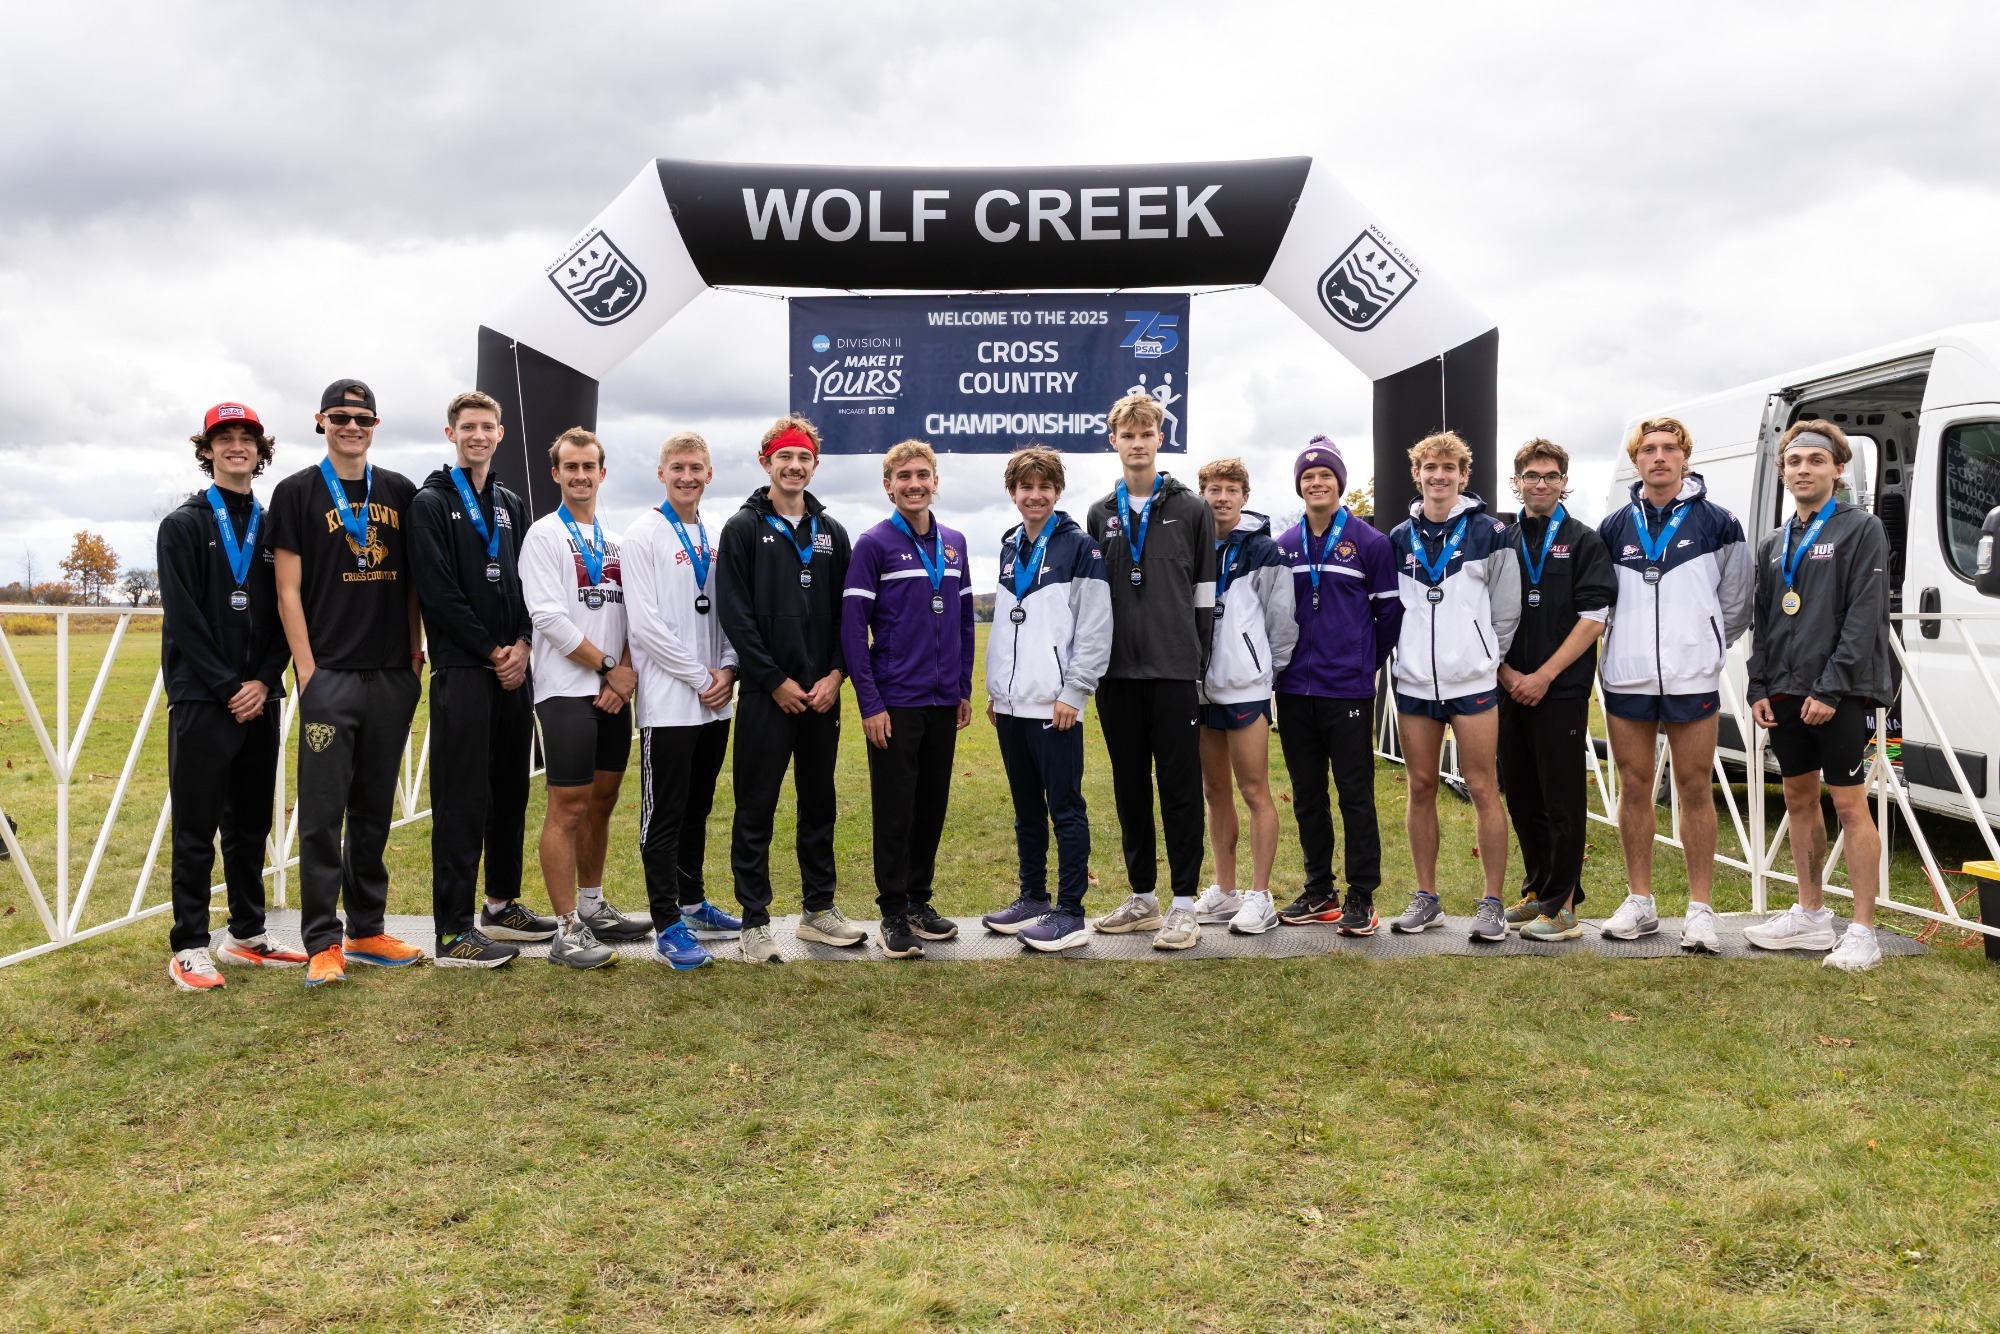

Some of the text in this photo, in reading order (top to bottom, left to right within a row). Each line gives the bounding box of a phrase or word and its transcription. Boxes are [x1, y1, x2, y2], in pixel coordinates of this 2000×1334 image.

[742, 185, 1224, 243] WOLF CREEK
[545, 226, 598, 272] WOLF CREEK
[1370, 224, 1422, 275] WOLF CREEK
[928, 311, 1109, 325] WELCOME TO THE 2025
[837, 338, 901, 348] DIVISION II
[1120, 311, 1179, 354] 75
[977, 341, 1059, 363] CROSS
[1135, 345, 1161, 353] PSAC
[844, 355, 904, 367] MAKE IT
[808, 360, 902, 403] YOURS
[958, 371, 1079, 394] COUNTRY
[219, 408, 244, 416] PSAC
[925, 413, 1108, 435] CHAMPIONSHIPS
[325, 503, 399, 533] KUZOWN
[343, 571, 397, 582] CROSS COUNTRY
[1866, 715, 1902, 731] MNA
